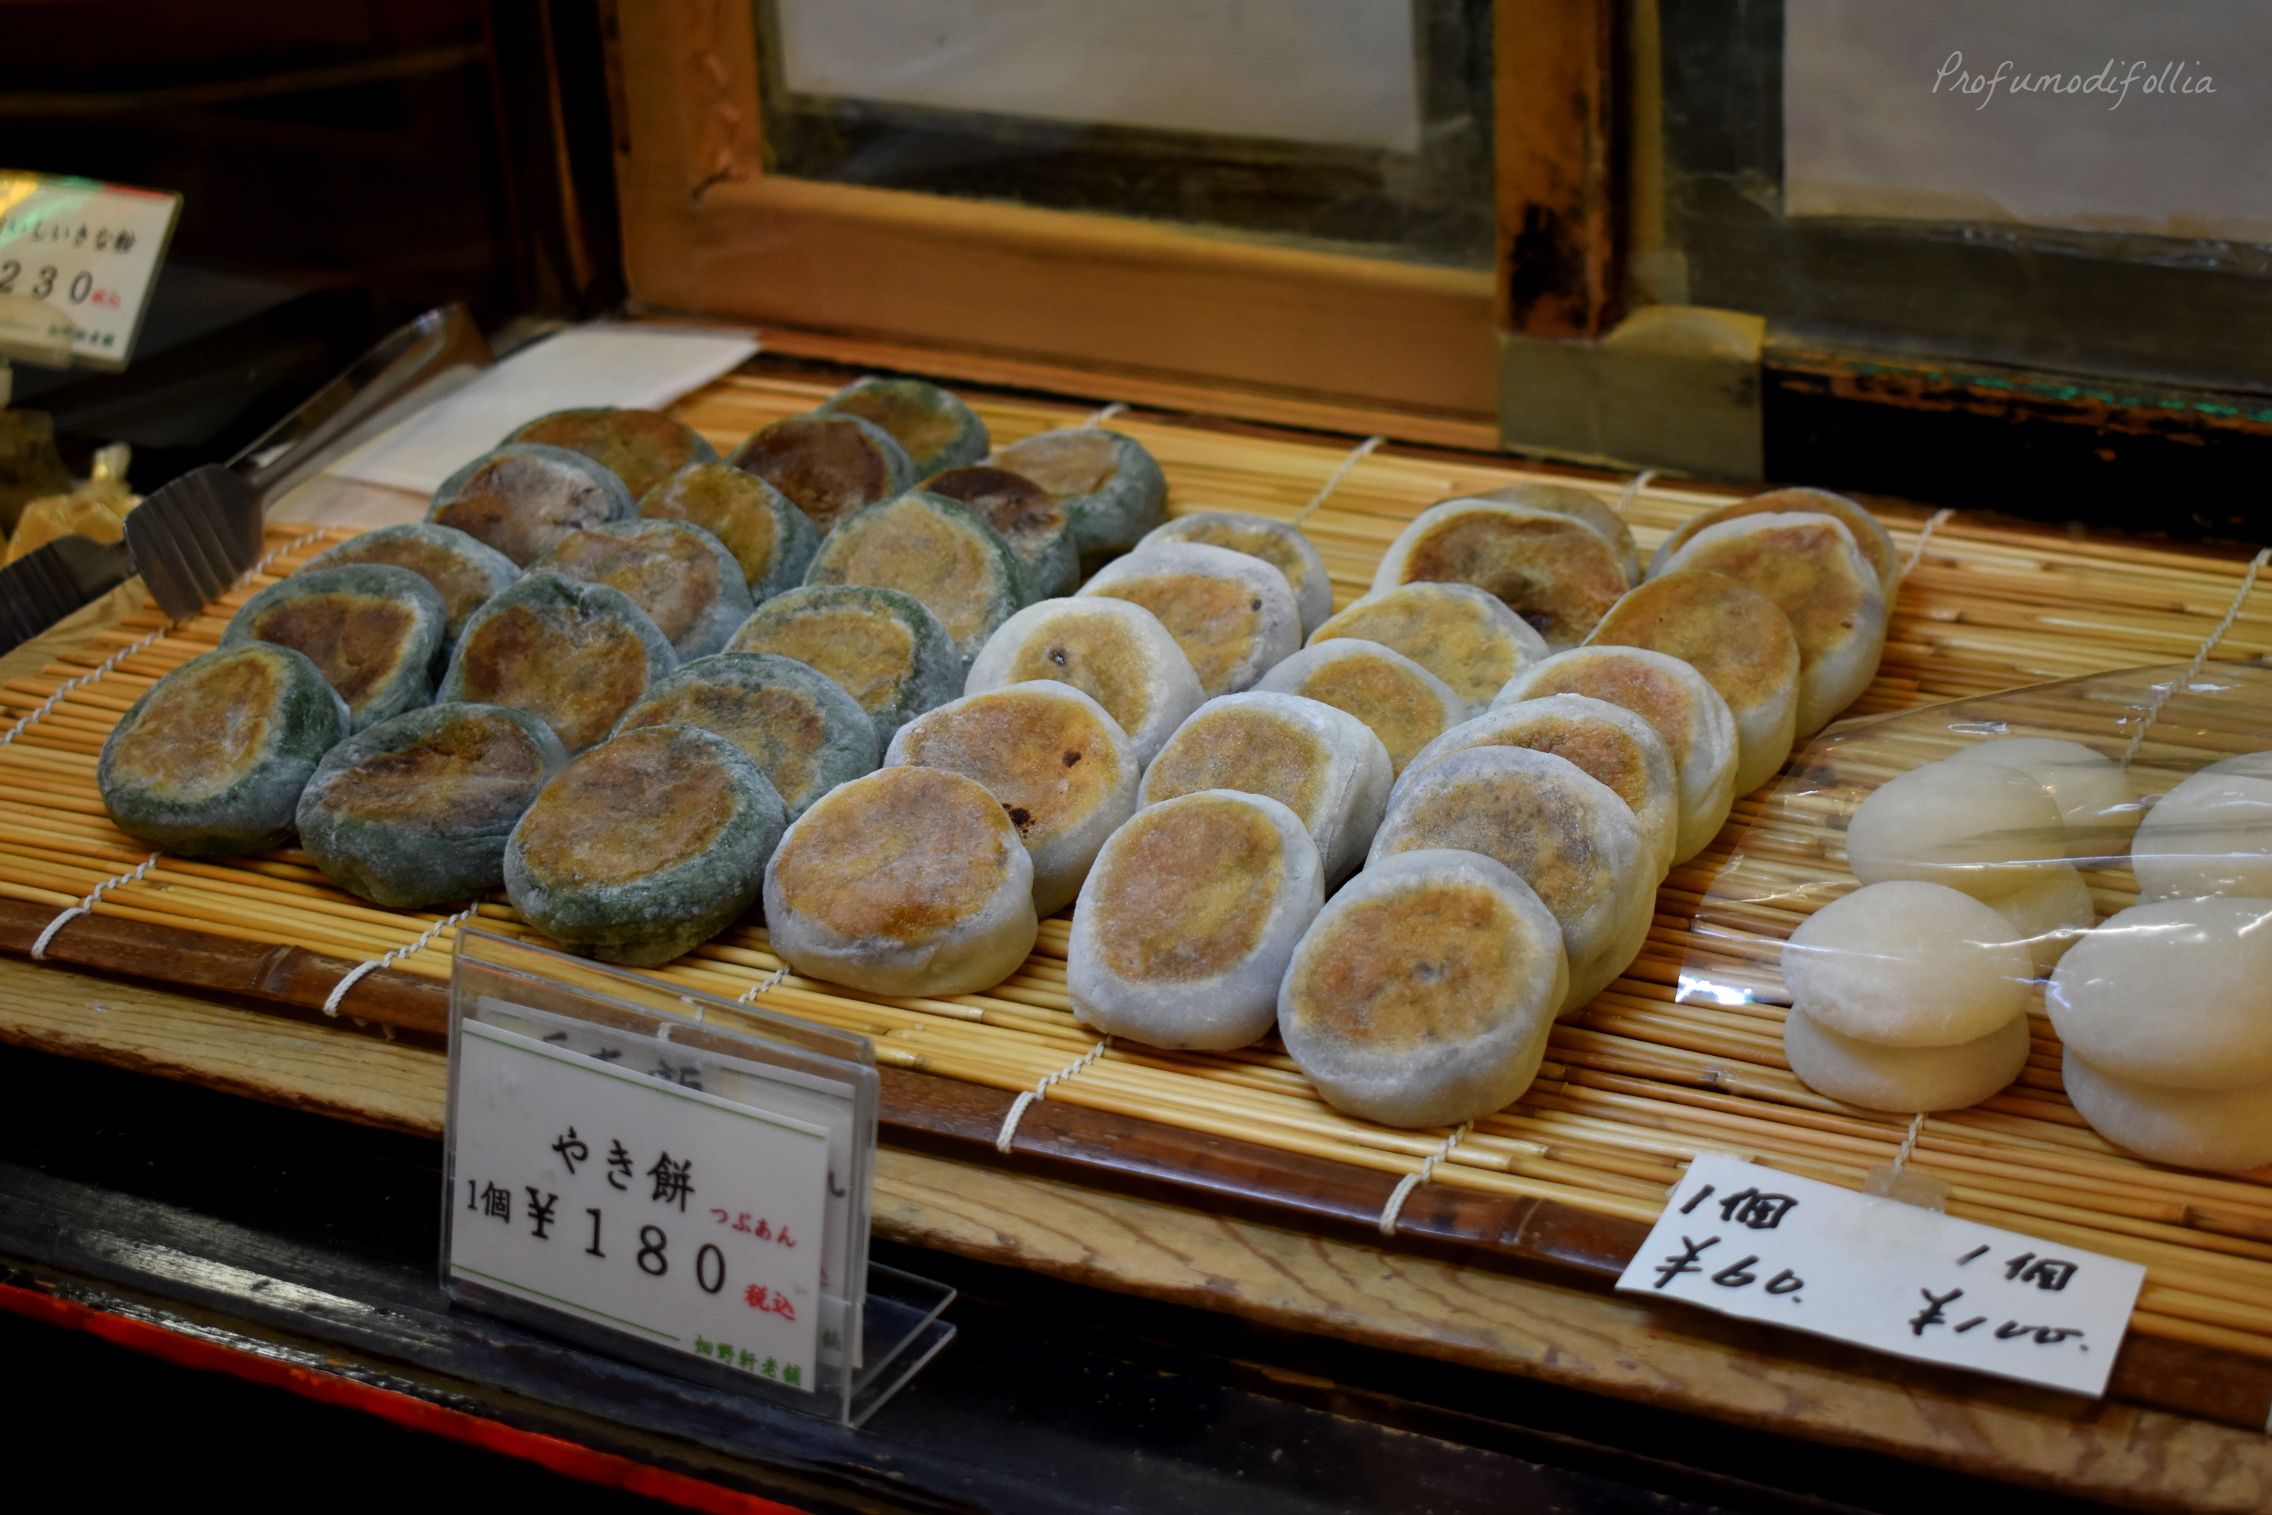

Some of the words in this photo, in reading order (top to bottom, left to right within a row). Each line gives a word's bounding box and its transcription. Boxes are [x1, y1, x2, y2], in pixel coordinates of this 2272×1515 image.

[552, 1126, 696, 1213] やき餅
[466, 1179, 512, 1225] 1個
[1680, 1185, 1798, 1230] 1個
[709, 1207, 798, 1249] つぶあん
[1956, 1244, 2079, 1292] 1個
[744, 1283, 797, 1322] 税込
